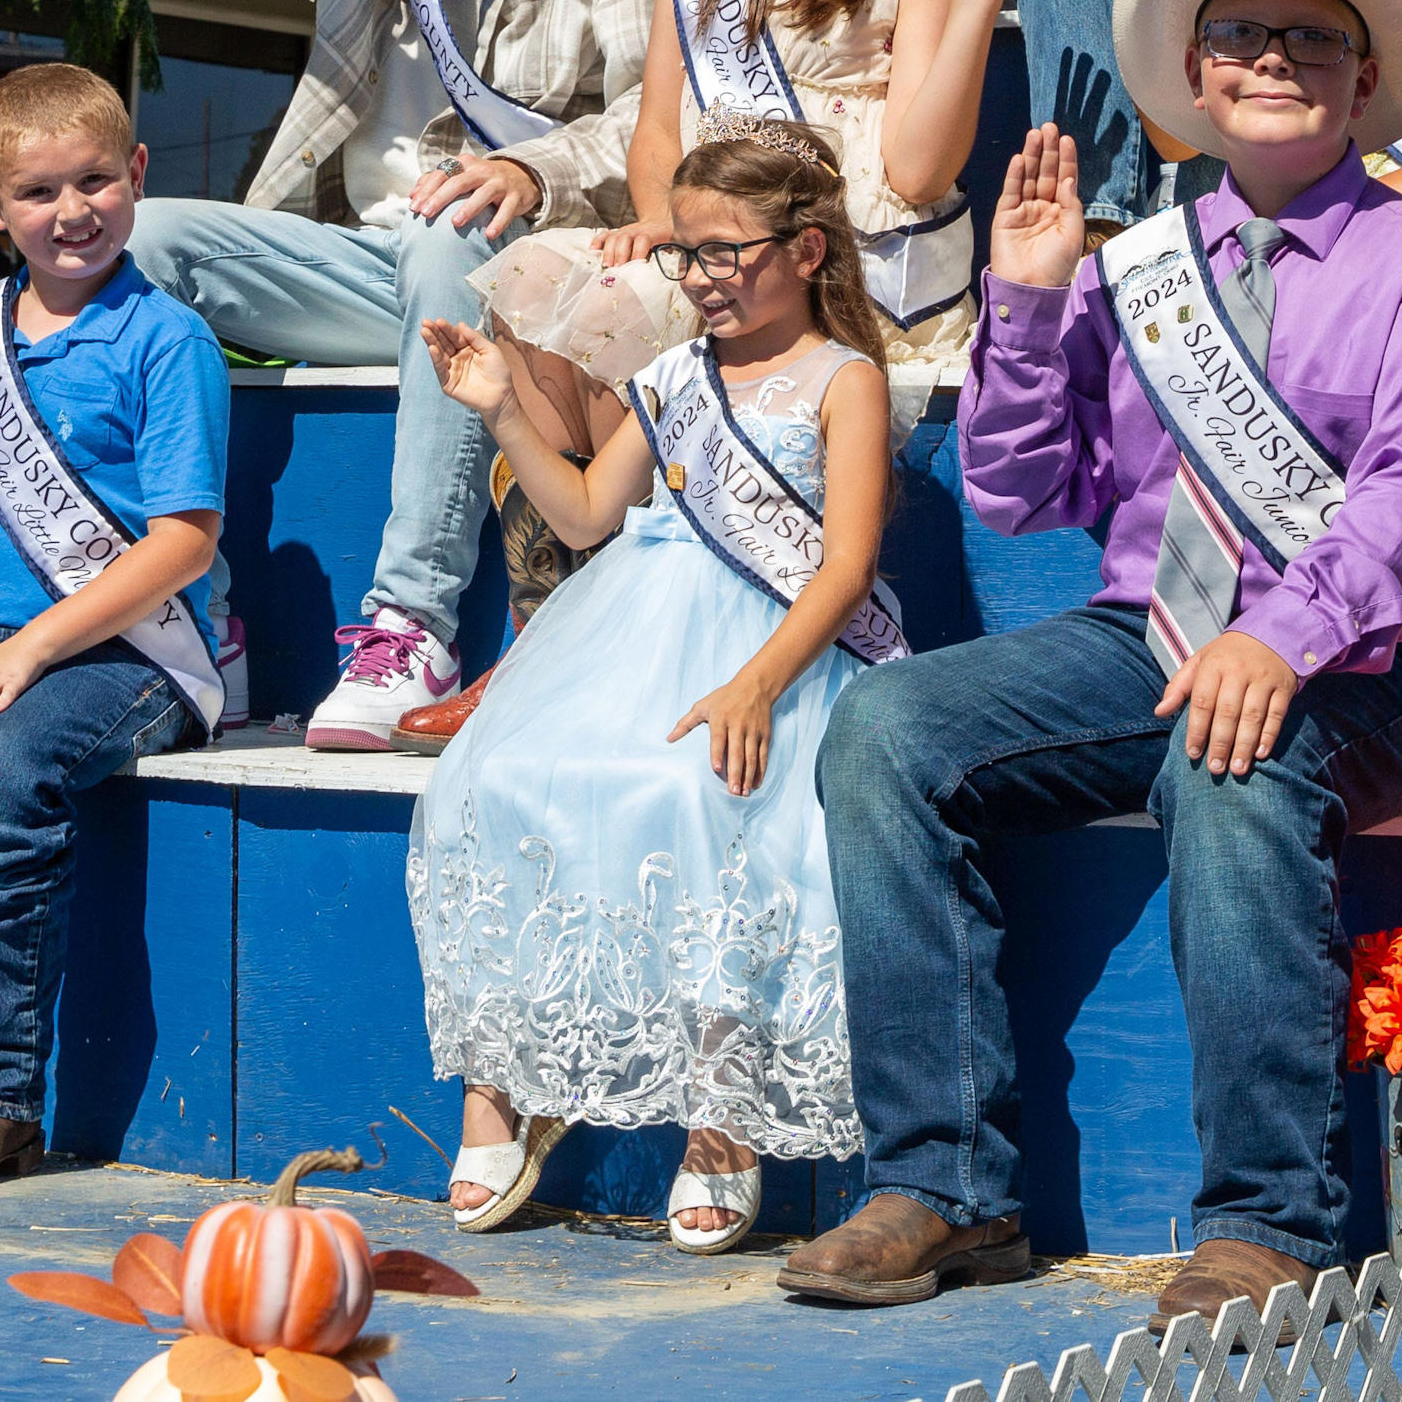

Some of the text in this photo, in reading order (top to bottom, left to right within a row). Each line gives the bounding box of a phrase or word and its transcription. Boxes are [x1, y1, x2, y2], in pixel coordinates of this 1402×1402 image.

[706, 36, 731, 87] Fair
[1128, 269, 1193, 320] 2024
[663, 393, 710, 456] 2024
[1184, 323, 1331, 501] SANDUSKY
[1167, 374, 1311, 551] Jr. Fair Junio
[12, 502, 60, 557] Little
[690, 479, 777, 566] Jr. Fair
